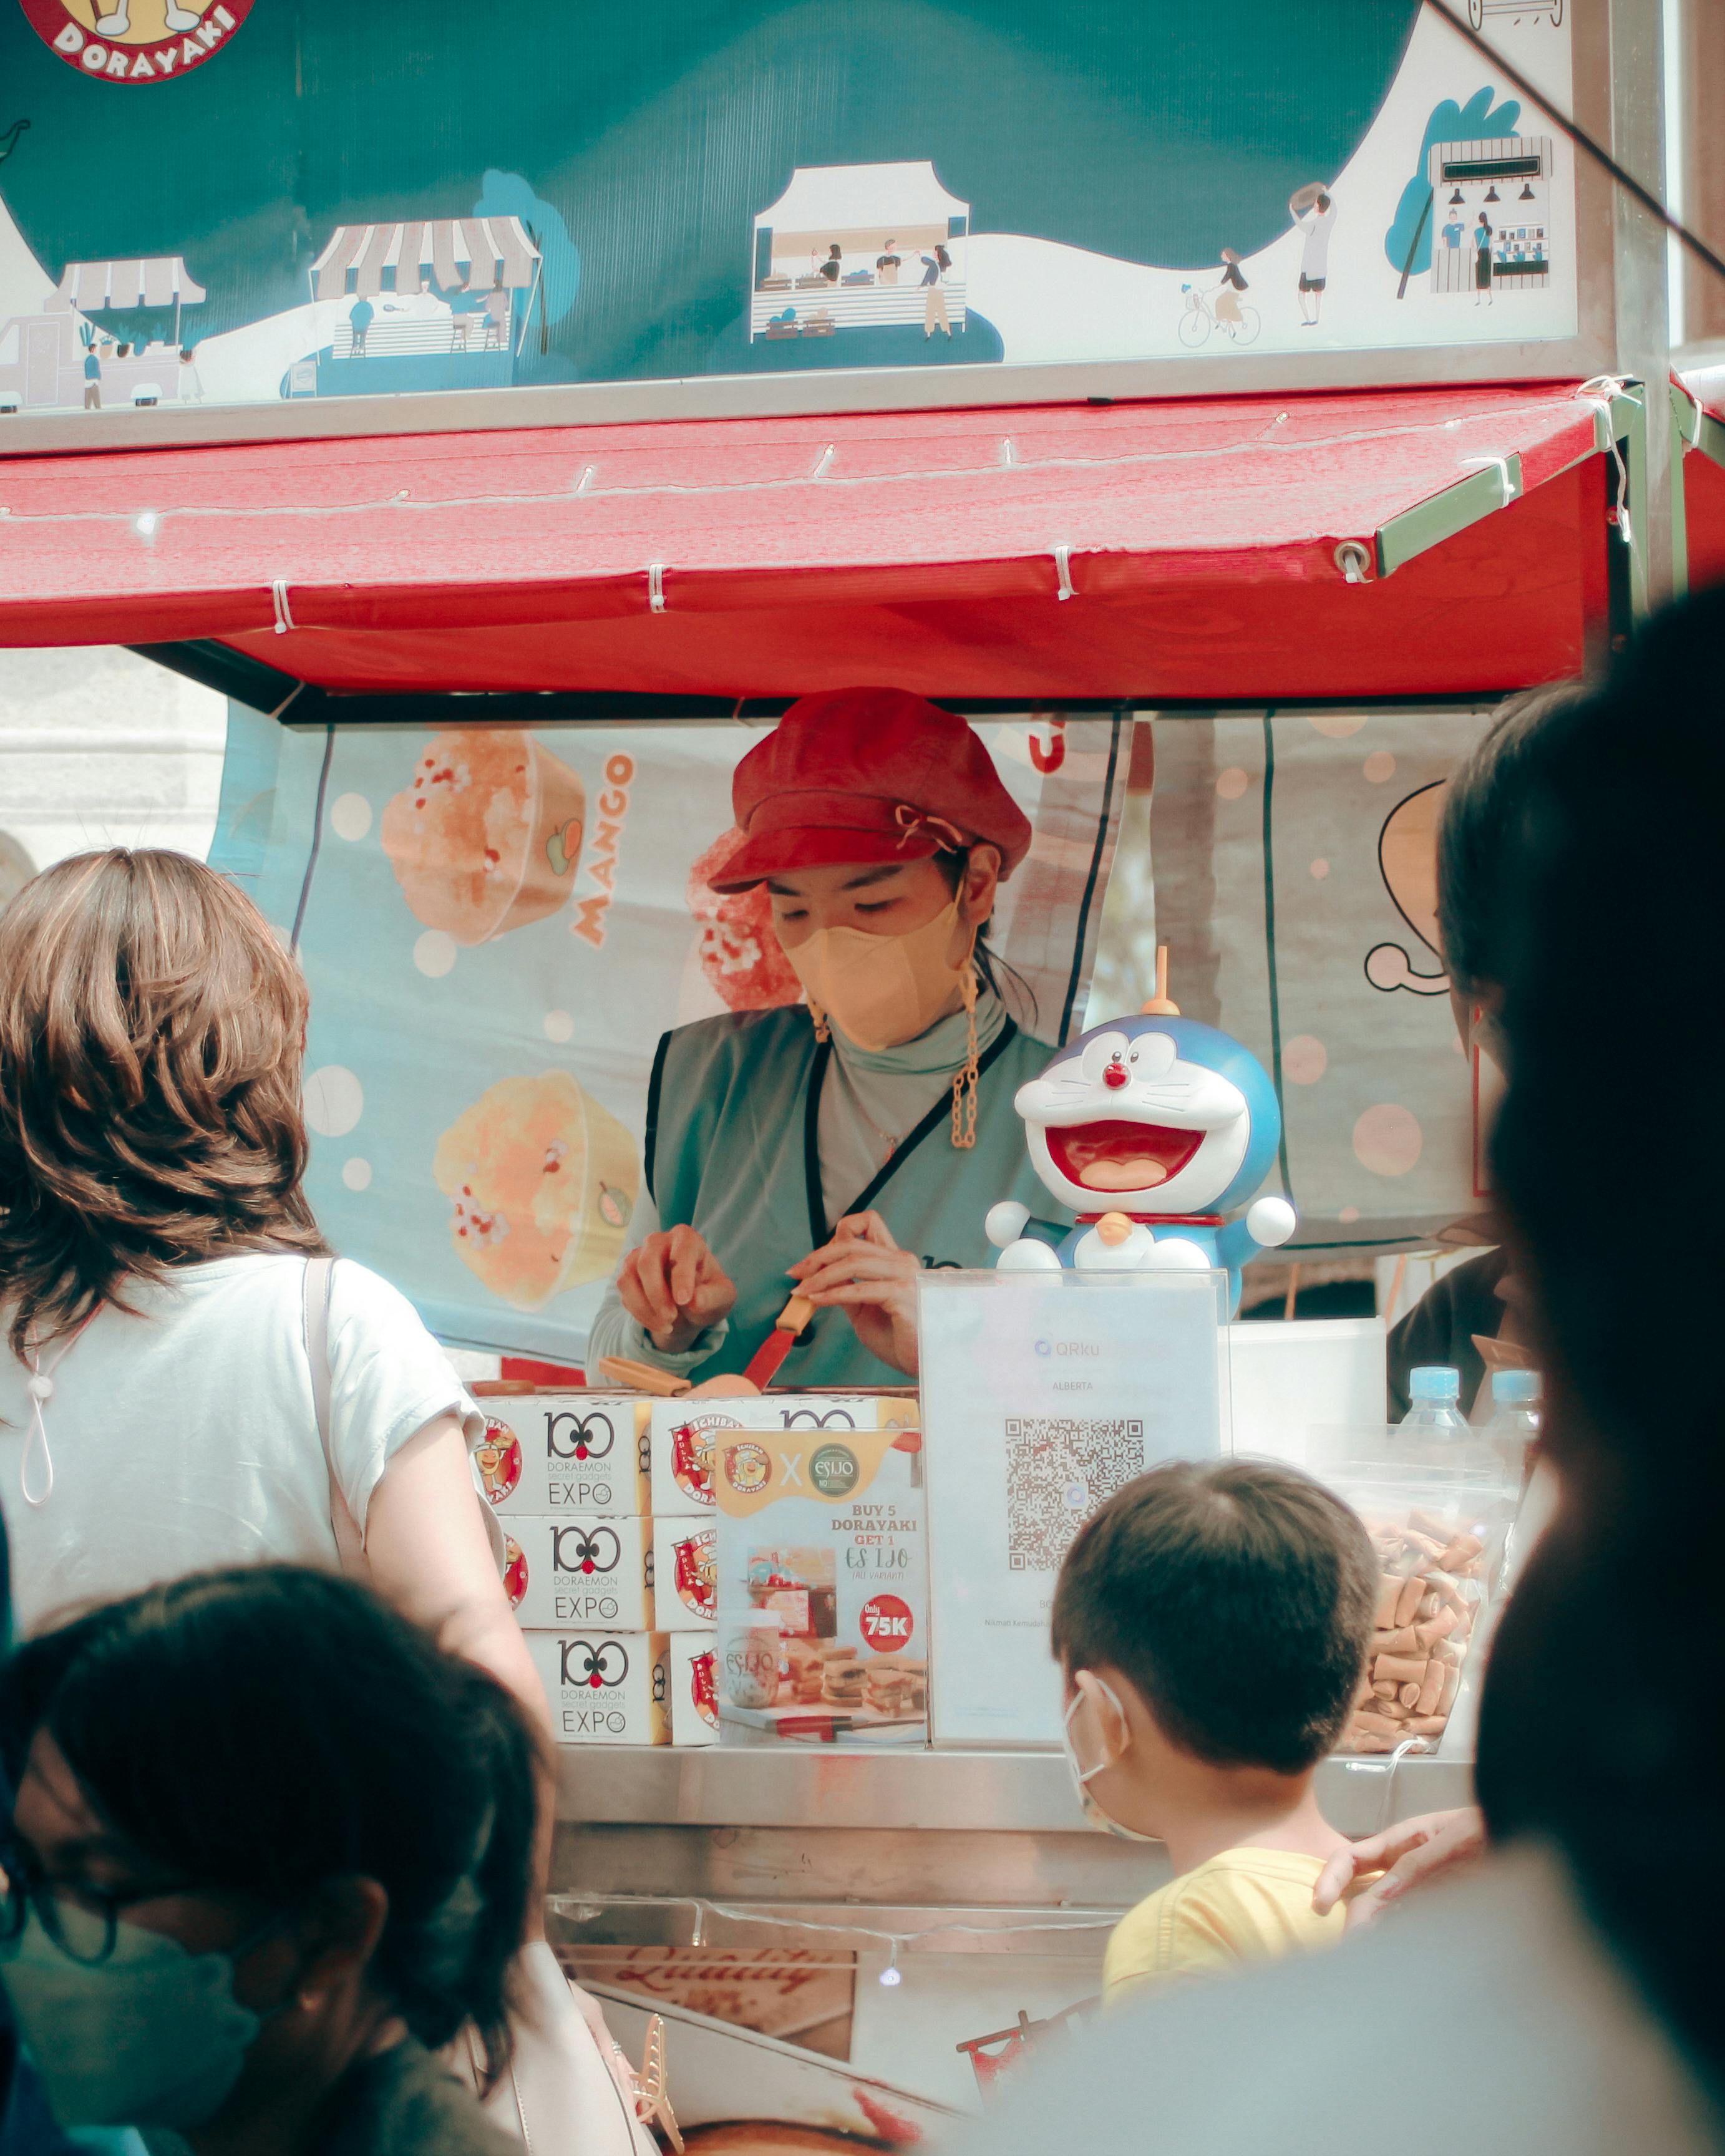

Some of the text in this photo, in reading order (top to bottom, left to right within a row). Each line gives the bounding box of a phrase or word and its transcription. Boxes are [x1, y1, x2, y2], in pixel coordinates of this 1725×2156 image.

[54, 5, 236, 77] DORAYAKI
[570, 754, 634, 948] MANGO
[1052, 1381, 1094, 1391] ALBERTA
[692, 1416, 740, 1430] ICHIBA
[548, 1462, 611, 1472] DORAEMON
[548, 1472, 612, 1483] secret gadgets
[732, 1480, 767, 1493] DORAYAKI
[549, 1482, 612, 1505] EXPO
[852, 1505, 897, 1517] BUY 5
[831, 1519, 917, 1532] DORAYAKI
[854, 1535, 894, 1545] GET 1
[554, 1576, 618, 1586] DORAEMON
[555, 1596, 618, 1619] EXPO
[865, 1604, 880, 1616] Only
[865, 1616, 908, 1636] 75K
[561, 1689, 626, 1701] DORAEMON
[563, 1711, 626, 1733] EXPO
